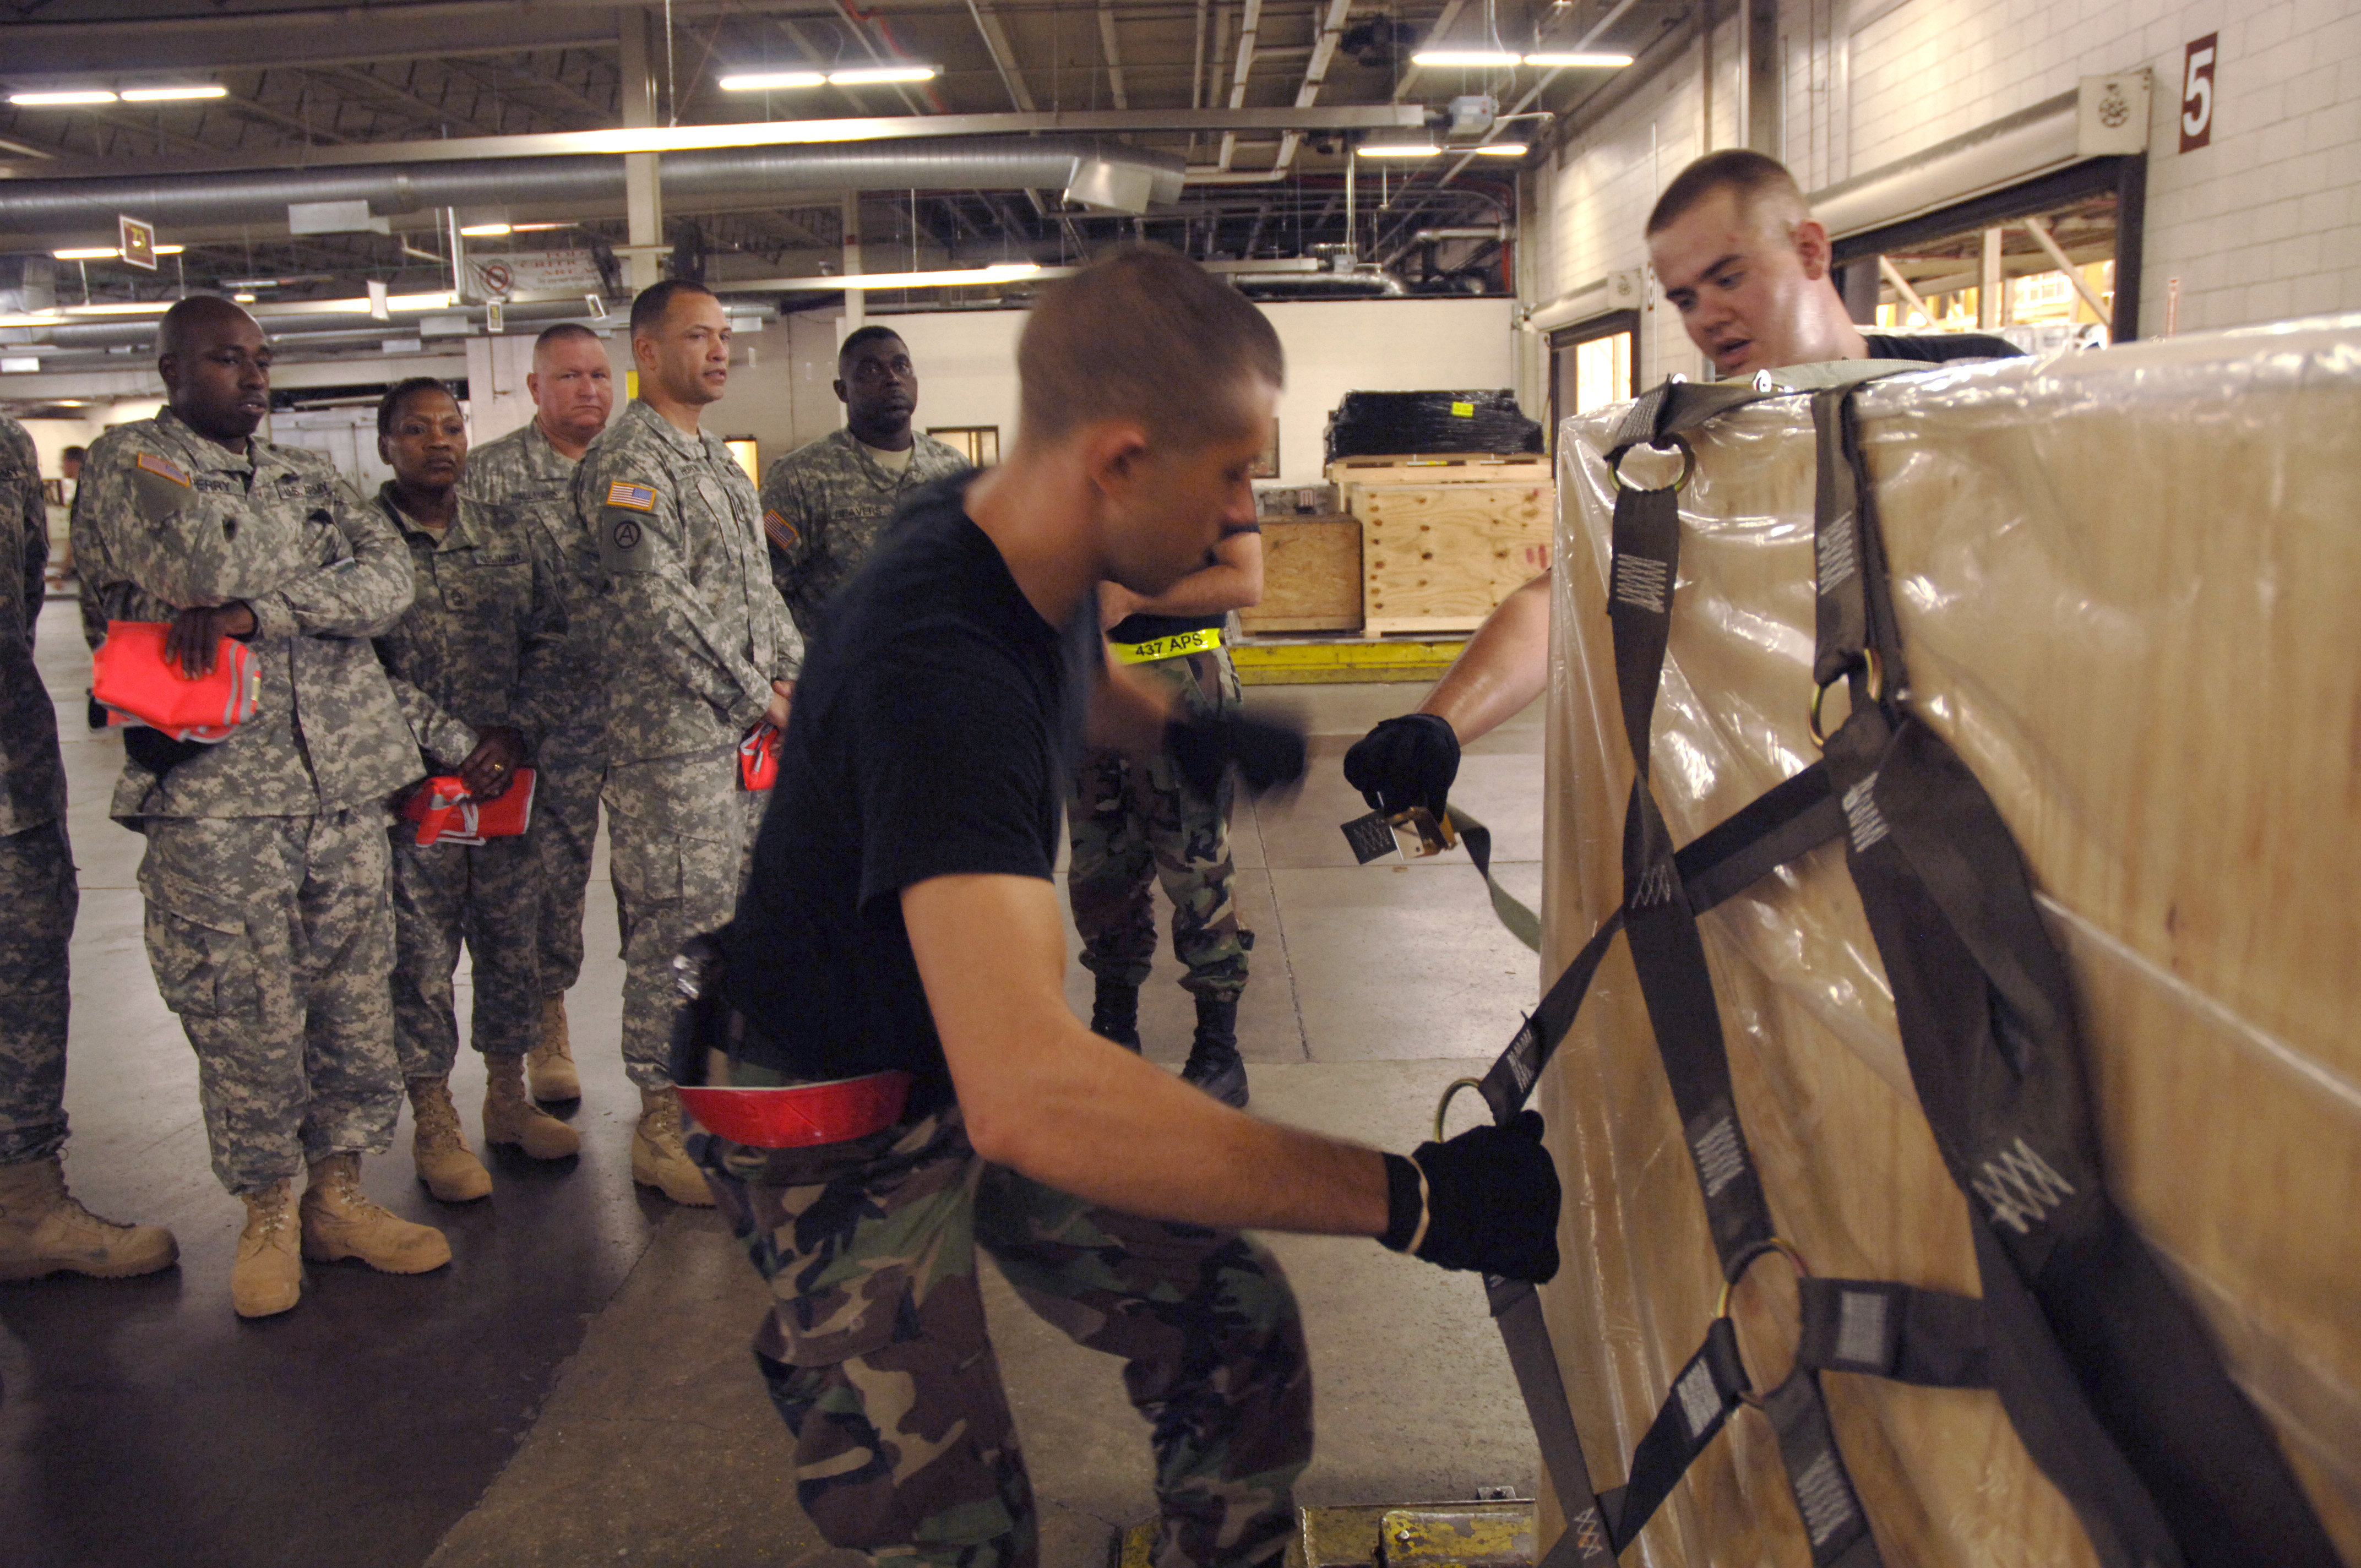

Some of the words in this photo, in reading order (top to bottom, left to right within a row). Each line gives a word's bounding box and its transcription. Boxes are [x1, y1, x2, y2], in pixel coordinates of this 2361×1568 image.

[2183, 46, 2214, 137] 5
[1135, 641, 1163, 656] 437
[1169, 632, 1204, 652] APS
